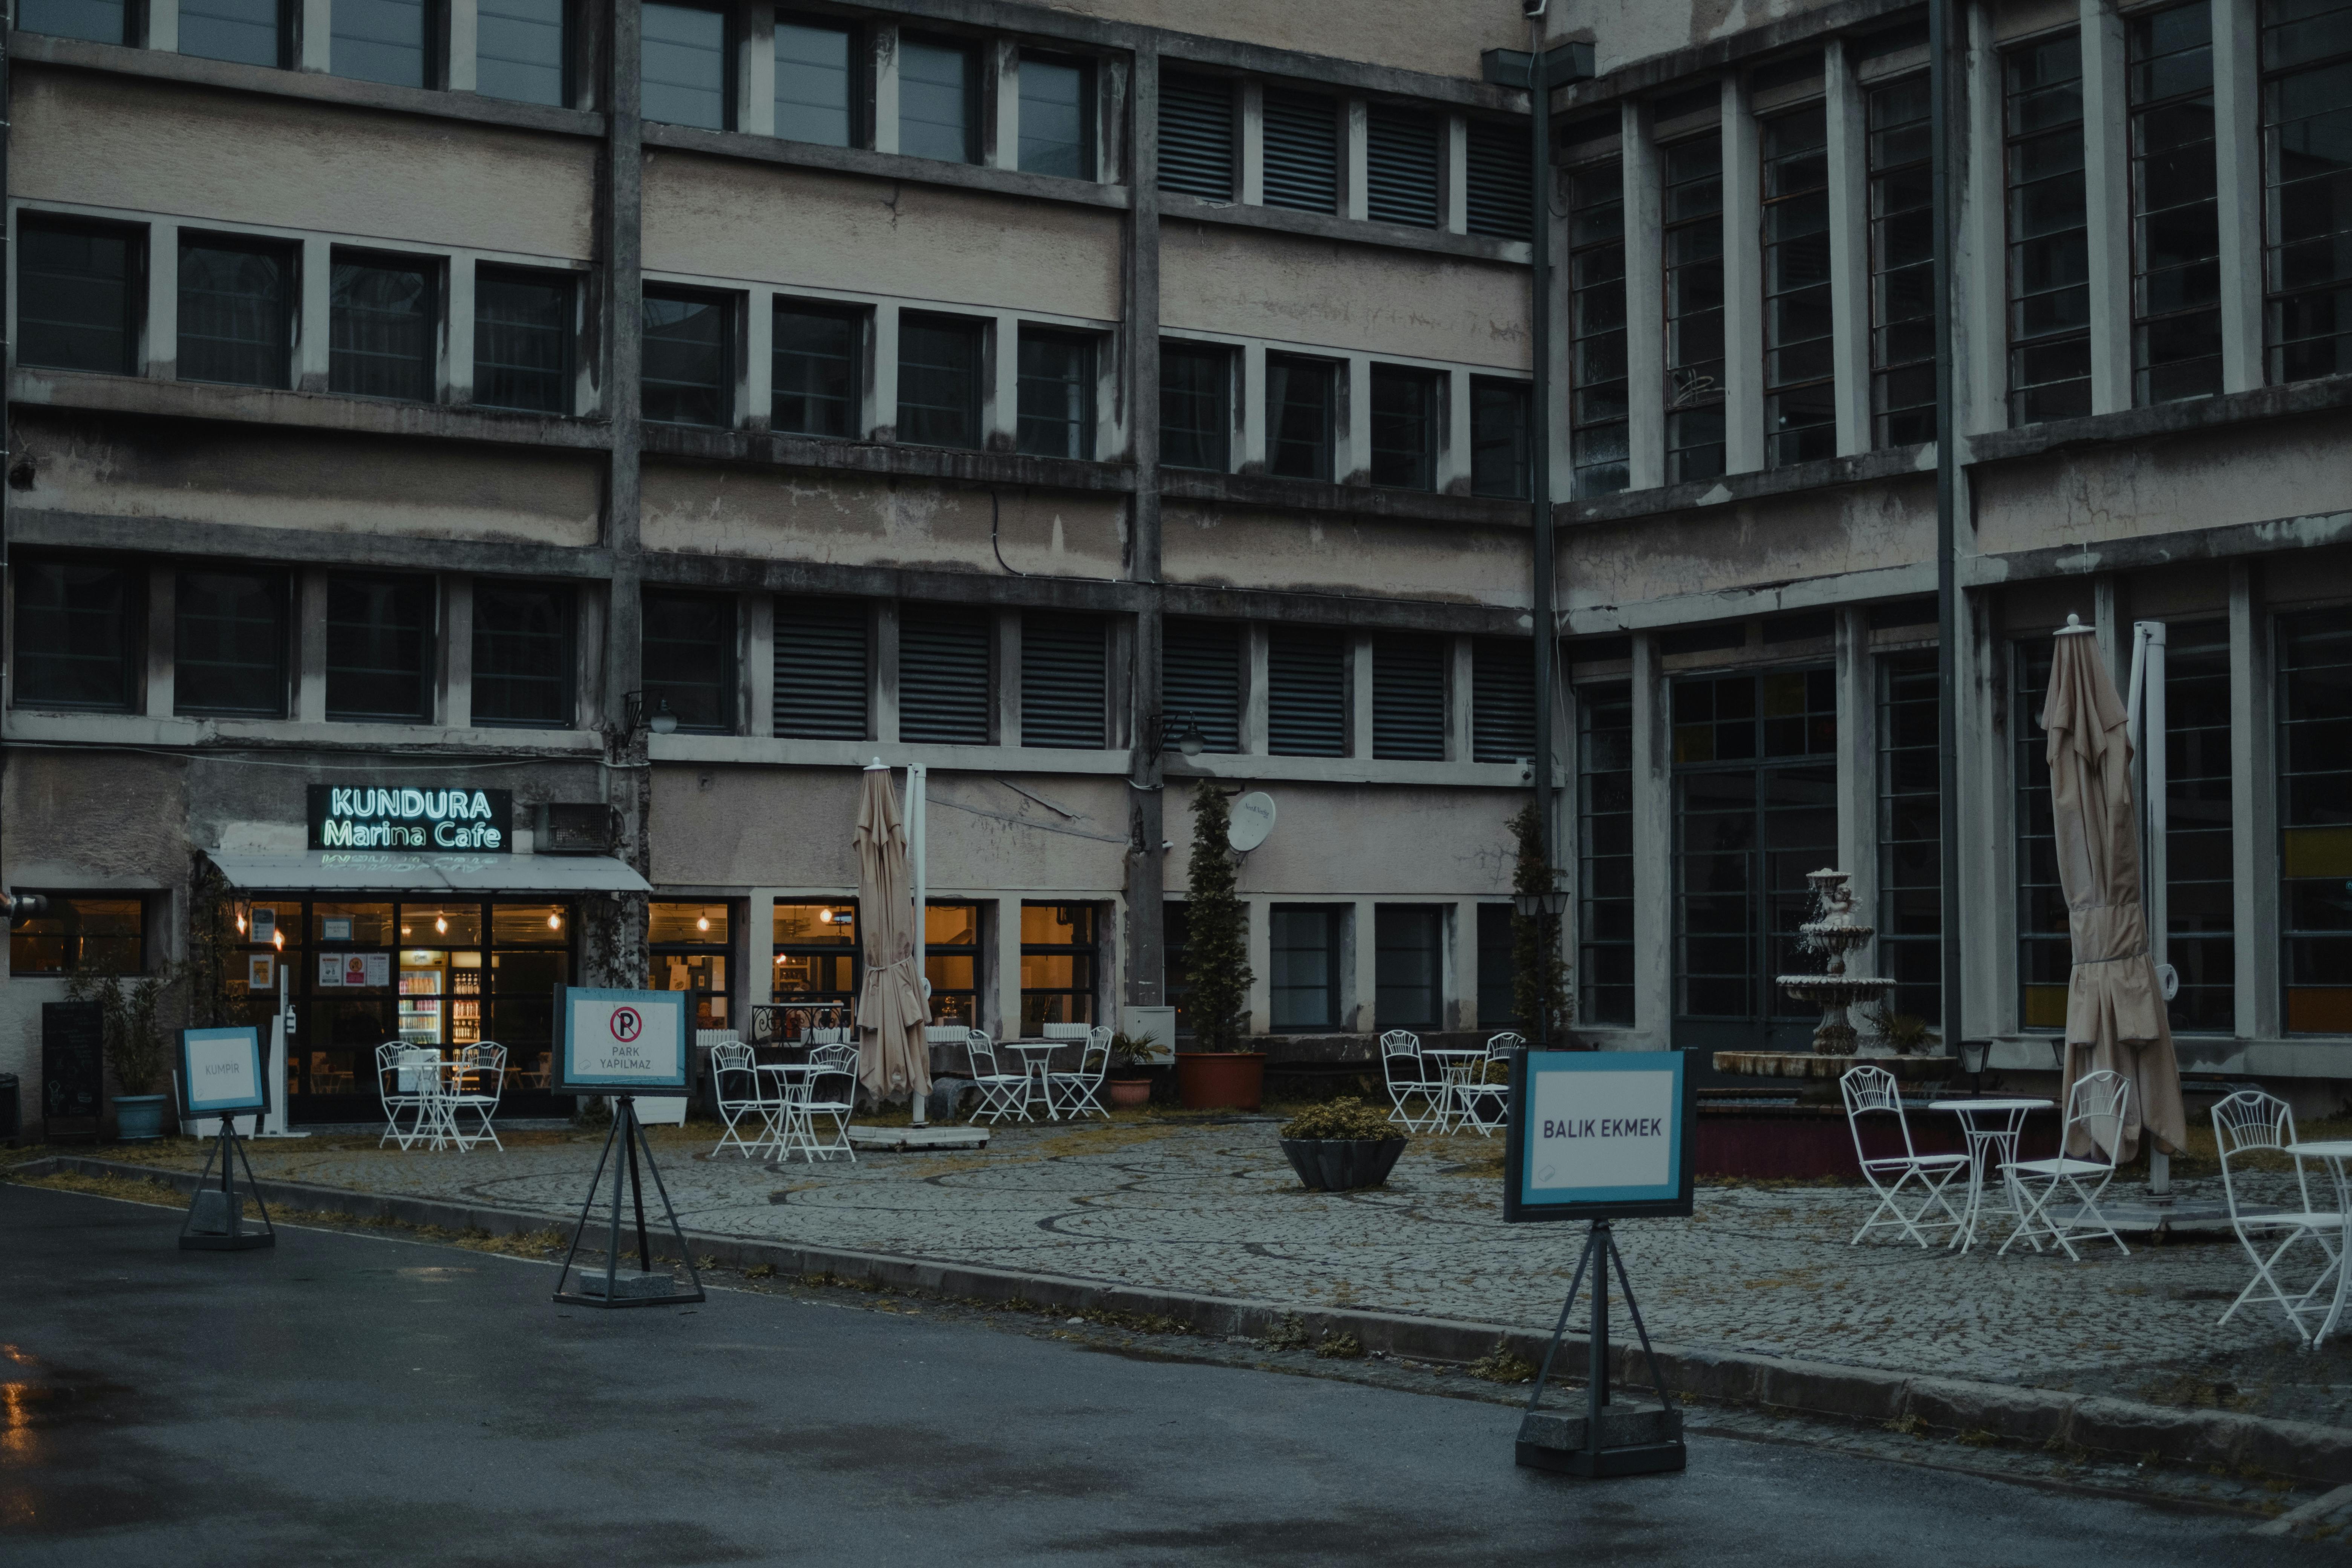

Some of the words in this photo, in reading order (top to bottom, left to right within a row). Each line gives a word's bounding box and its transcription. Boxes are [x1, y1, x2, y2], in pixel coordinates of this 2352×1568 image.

[332, 788, 492, 818] KUNDURA
[324, 819, 426, 846] Marina
[434, 821, 501, 848] Cafe
[612, 1046, 640, 1057] PARK
[205, 1061, 240, 1075] KUMPİR
[600, 1058, 651, 1069] YAPILMAZ
[1543, 1119, 1596, 1138] BALIK
[1601, 1118, 1662, 1137] EKMEK
